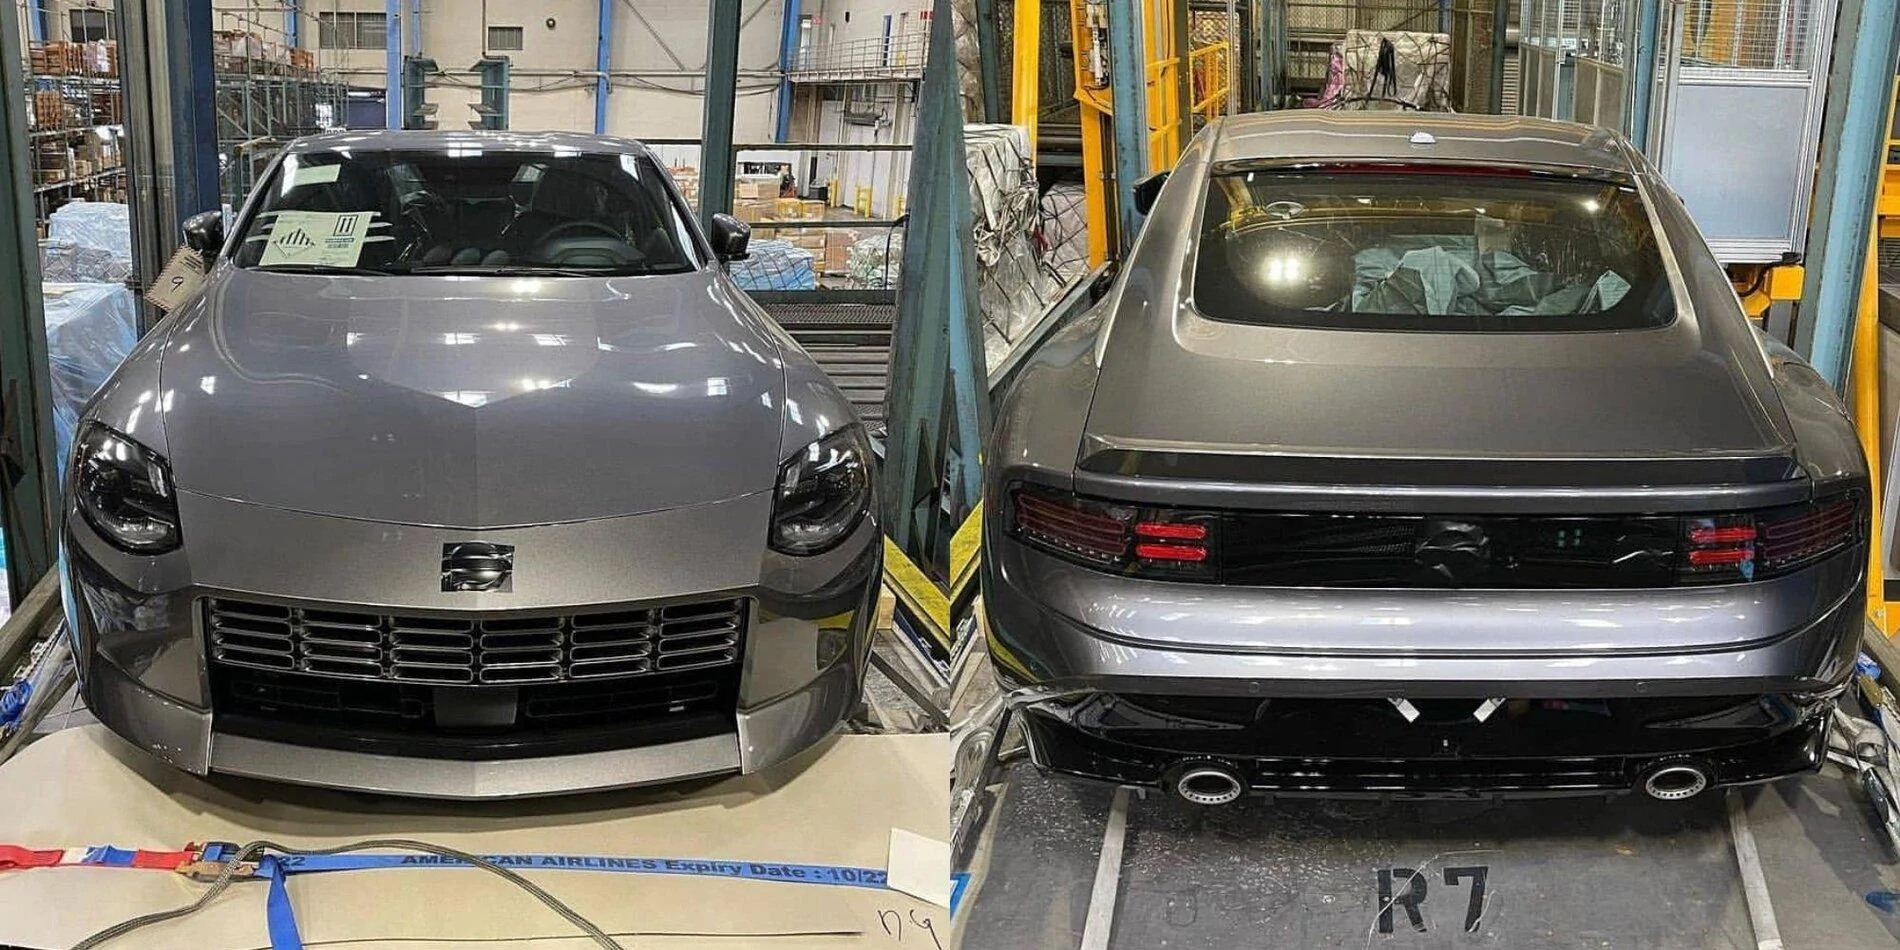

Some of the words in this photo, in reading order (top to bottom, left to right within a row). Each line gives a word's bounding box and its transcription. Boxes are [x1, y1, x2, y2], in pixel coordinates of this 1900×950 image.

[400, 855, 534, 866] AMECAN
[541, 855, 657, 869] AIRLINES
[665, 859, 742, 877] Expiry
[749, 863, 806, 878] Date
[813, 869, 823, 880] :
[1377, 866, 1489, 933] R7
